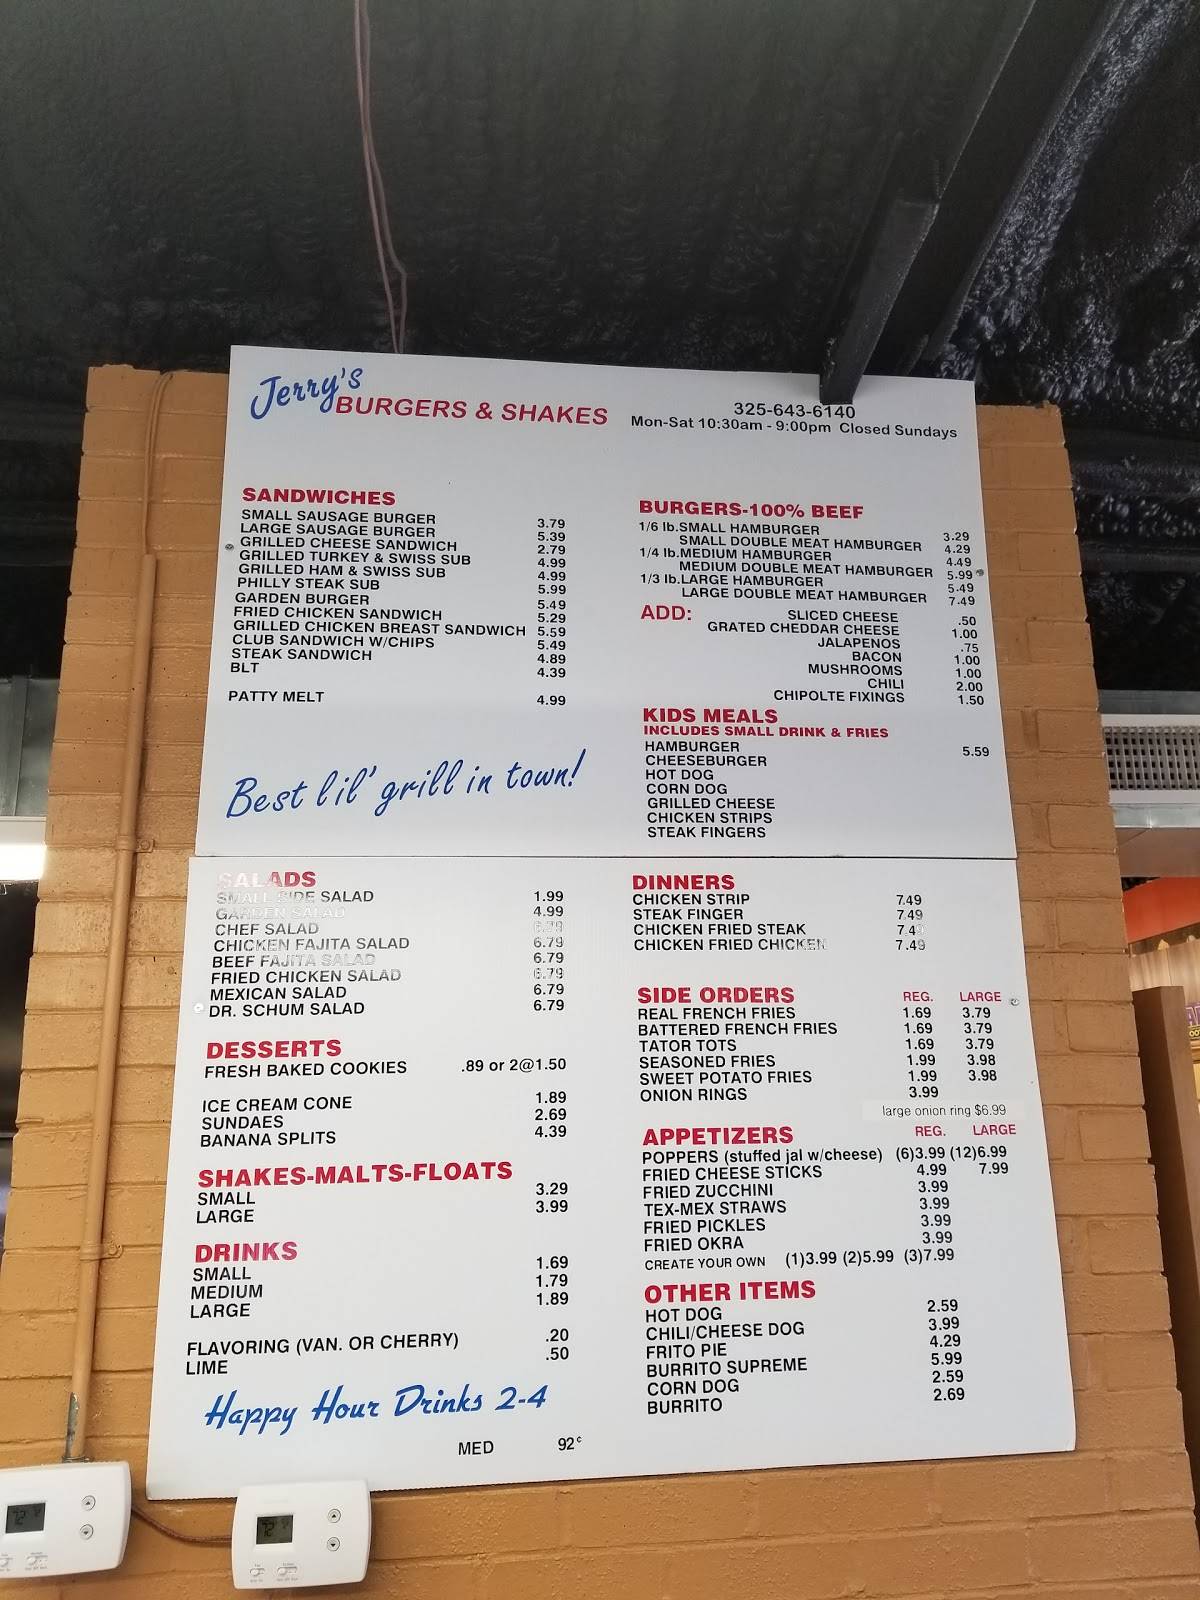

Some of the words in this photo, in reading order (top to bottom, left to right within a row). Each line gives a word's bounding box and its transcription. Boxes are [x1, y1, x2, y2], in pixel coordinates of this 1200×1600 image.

[250, 368, 364, 420] Jerry's
[334, 397, 467, 419] BURGERS
[475, 402, 492, 420] &
[501, 404, 607, 425] SHAKES
[733, 402, 856, 419] 325-643-6140
[631, 415, 695, 428] Mon-Sat
[699, 418, 763, 431] 10:30am
[775, 420, 832, 435] 9:00pm
[839, 422, 891, 436] Closed
[895, 425, 958, 441] Sundays
[242, 488, 395, 505] SANDWICHES
[242, 509, 292, 521] SMALL
[297, 511, 368, 522] SAUSAGE
[374, 512, 435, 524] BURGER
[640, 501, 805, 517] BURGERS-100%
[812, 504, 863, 518] BEEF
[538, 518, 565, 529] 3.79
[240, 536, 305, 548] GRILLED
[310, 538, 371, 549] CHEESE
[376, 539, 456, 551] SANDWICH
[538, 544, 565, 555] 2.79
[680, 535, 726, 546] SMALL
[731, 536, 787, 547] DOUBLE
[792, 538, 829, 549] MEAT
[834, 539, 921, 551] HAMBURGER
[945, 544, 970, 554] 4.29
[240, 550, 304, 562] GRILLED
[309, 551, 369, 563] TURKEY
[374, 552, 383, 563] &
[389, 553, 436, 564] SWISS
[441, 554, 470, 565] SUB
[538, 558, 566, 568] 4.99
[238, 577, 290, 588] PHILLY
[296, 578, 344, 589] STEAK
[350, 579, 379, 590] SUB
[538, 584, 566, 594] 5.99
[235, 592, 300, 604] GARDEN
[306, 593, 369, 605] BURGER
[538, 599, 566, 610] 5.49
[641, 605, 691, 620] ADD:
[788, 610, 838, 621] SLICED
[843, 611, 898, 622] CHEESE
[234, 620, 299, 631] GRILLED
[305, 621, 374, 633] CHICKEN
[380, 623, 440, 634] BREAST
[445, 624, 525, 636] SANDWICH
[959, 616, 976, 626] .50
[538, 626, 566, 637] 5.59
[818, 637, 900, 649] JALAPENOS
[961, 642, 979, 653] .75
[231, 662, 259, 673] BLT
[537, 667, 566, 677] 4.39
[809, 664, 902, 675] MUSHROOMS
[956, 668, 981, 678] 1.00
[229, 690, 278, 702] PATTY
[283, 691, 324, 702] MELT
[537, 695, 566, 706] 4.99
[774, 690, 845, 701] CHIPOLTE
[850, 691, 904, 702] FIXINGS
[958, 695, 984, 705] 1.50
[644, 708, 696, 723] KIDS
[704, 708, 778, 723] MEALS
[644, 725, 720, 736] INCLUDES
[725, 726, 774, 736] SMALL
[779, 727, 825, 737] DRINK
[831, 727, 840, 737] &
[847, 727, 888, 737] FRIES
[963, 746, 989, 757] 5.59
[646, 755, 767, 766] CHEESEBURGER
[226, 777, 308, 818] Best
[316, 765, 377, 806] lil'
[374, 760, 463, 817] grill
[466, 765, 492, 794] in
[506, 749, 586, 789] town!
[647, 783, 689, 794] CORN
[695, 783, 727, 795] DOG
[648, 826, 696, 838] STEAK
[701, 826, 766, 838] FINGERS
[633, 875, 735, 890] DINNERS
[634, 908, 682, 920] STEAK
[688, 908, 743, 920] FINGER
[211, 987, 286, 1000] MEXICAN
[292, 987, 346, 999] SALAD
[534, 983, 564, 995] 6.79
[638, 987, 691, 1003] SIDE
[700, 987, 794, 1003] ORDERS
[903, 991, 933, 1002] REG.
[960, 991, 1001, 1002] LARGE
[639, 1023, 719, 1036] BATTERED
[725, 1022, 788, 1035] FRENCH
[794, 1022, 837, 1035] FRIES
[904, 1022, 932, 1034] 1.69
[964, 1022, 992, 1034] 3.79
[207, 1040, 341, 1059] DESSERTS
[205, 1064, 260, 1078] FRESH
[267, 1063, 324, 1077] BAKED
[331, 1061, 406, 1075] COOKIES
[462, 1059, 483, 1072] .89
[489, 1059, 504, 1071] or
[510, 1058, 566, 1071] 2@1.50
[640, 1089, 692, 1101] ONION
[698, 1088, 747, 1101] RINGS
[909, 1086, 938, 1098] 3.99
[535, 1108, 566, 1121] 2.69
[883, 1105, 911, 1118] large
[915, 1105, 946, 1116] onion
[950, 1105, 971, 1118] ring
[975, 1104, 1006, 1115] $6.99
[202, 1115, 283, 1130] SUNDAES
[643, 1127, 793, 1146] APPETIZERS
[643, 1151, 718, 1164] POPPERS
[725, 1150, 780, 1166] (stuffed
[786, 1149, 802, 1165] jal
[808, 1148, 882, 1163] w/cheese)
[896, 1146, 945, 1163] (6)3.99
[950, 1145, 1007, 1162] (12)6.99
[198, 1162, 512, 1188] SHAKES-MALTS-FLOATS
[536, 1200, 568, 1213] 3.99
[197, 1209, 254, 1223] LARGE
[921, 1214, 951, 1227] 3.99
[644, 1219, 691, 1233] FRIED
[698, 1218, 765, 1233] PICKLES
[195, 1242, 297, 1263] DRINKS
[786, 1251, 837, 1268] (1)3.99
[843, 1250, 894, 1266] (2)5.99
[904, 1248, 954, 1265] (3)7.99
[536, 1273, 568, 1287] 1.79
[191, 1285, 262, 1300] MEDIUM
[645, 1283, 730, 1303] OTHER
[740, 1280, 815, 1300] ITEMS
[929, 1317, 959, 1330] 3.99
[546, 1328, 569, 1342] .20
[646, 1323, 763, 1340] CHILI/CHEESE
[769, 1322, 804, 1337] DOG
[187, 1338, 289, 1355] FLAVORING
[297, 1336, 342, 1354] (VAN.
[349, 1335, 374, 1351] OR
[381, 1333, 458, 1350] CHERRY)
[934, 1387, 965, 1401] 2.69
[204, 1390, 298, 1436] Happy
[312, 1385, 380, 1425] Hour
[394, 1384, 483, 1417] Drinks
[495, 1384, 548, 1411] 2-4
[648, 1398, 722, 1414] BURRITO
[459, 1441, 494, 1455] MED
